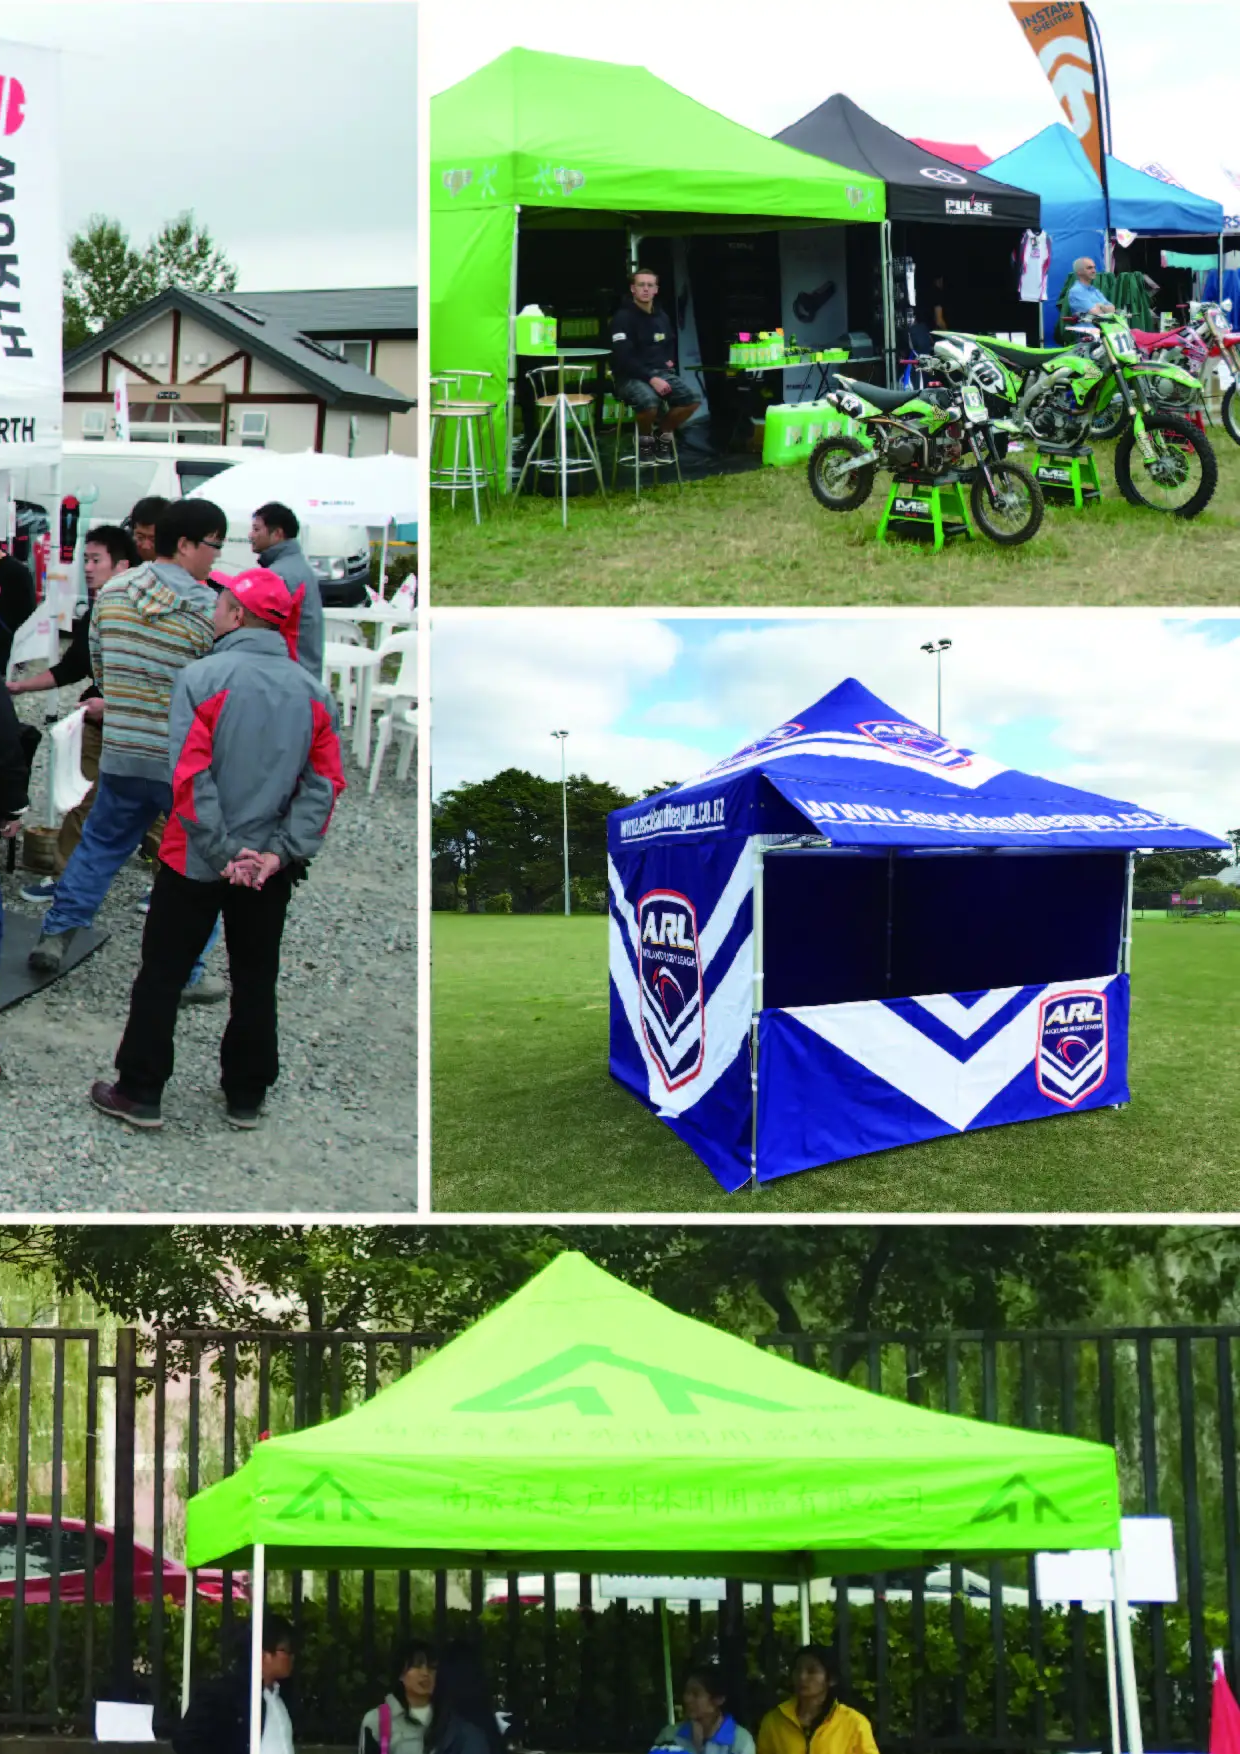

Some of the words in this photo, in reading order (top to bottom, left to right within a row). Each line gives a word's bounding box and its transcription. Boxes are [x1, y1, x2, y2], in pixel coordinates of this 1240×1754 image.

[1033, 9, 1074, 35] SHELTERS
[945, 198, 993, 213] PULSE
[642, 911, 695, 951] ARL
[1045, 1002, 1102, 1027] ARL
